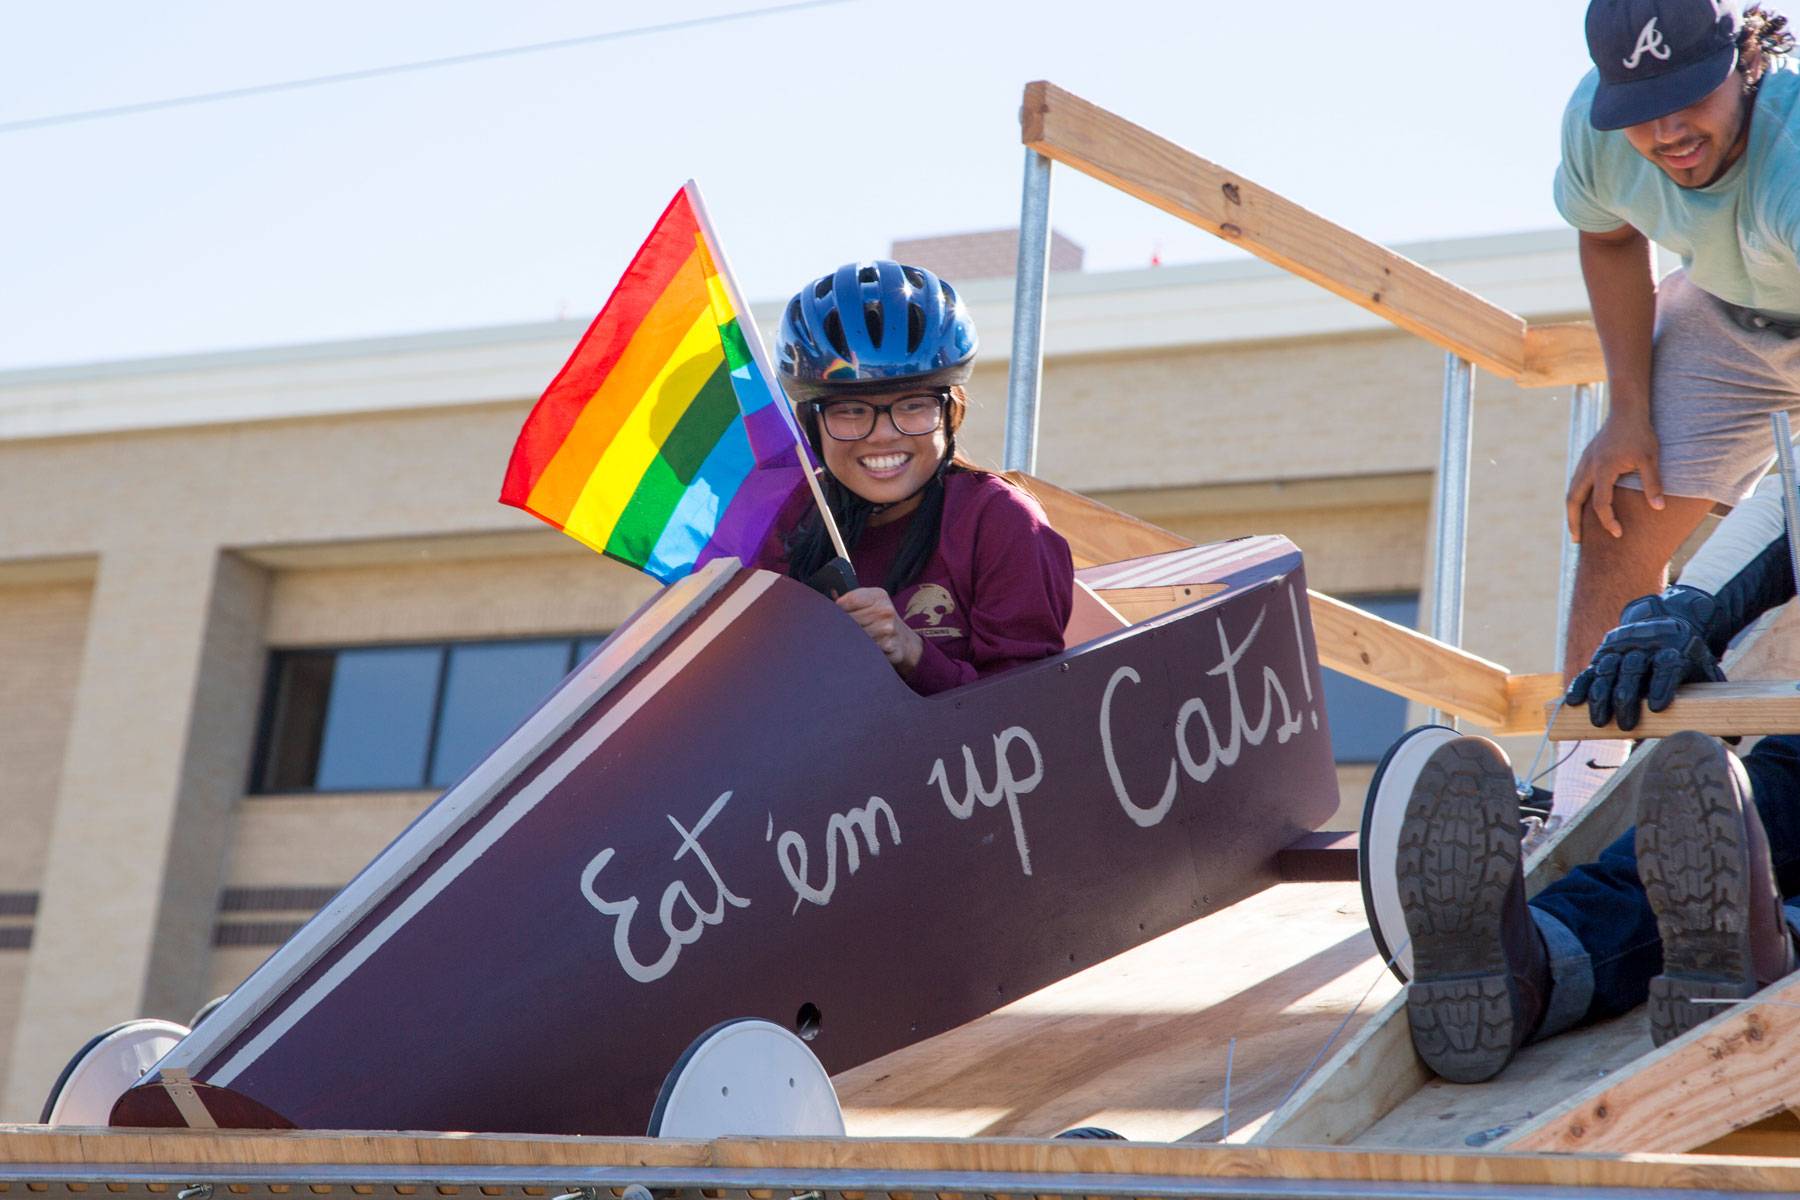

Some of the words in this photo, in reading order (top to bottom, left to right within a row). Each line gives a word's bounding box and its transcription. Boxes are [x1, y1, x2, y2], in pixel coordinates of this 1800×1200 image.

[1622, 16, 1672, 69] A
[580, 790, 751, 983] Eat
[926, 725, 1044, 876] up
[1099, 583, 1320, 828] Cats!
